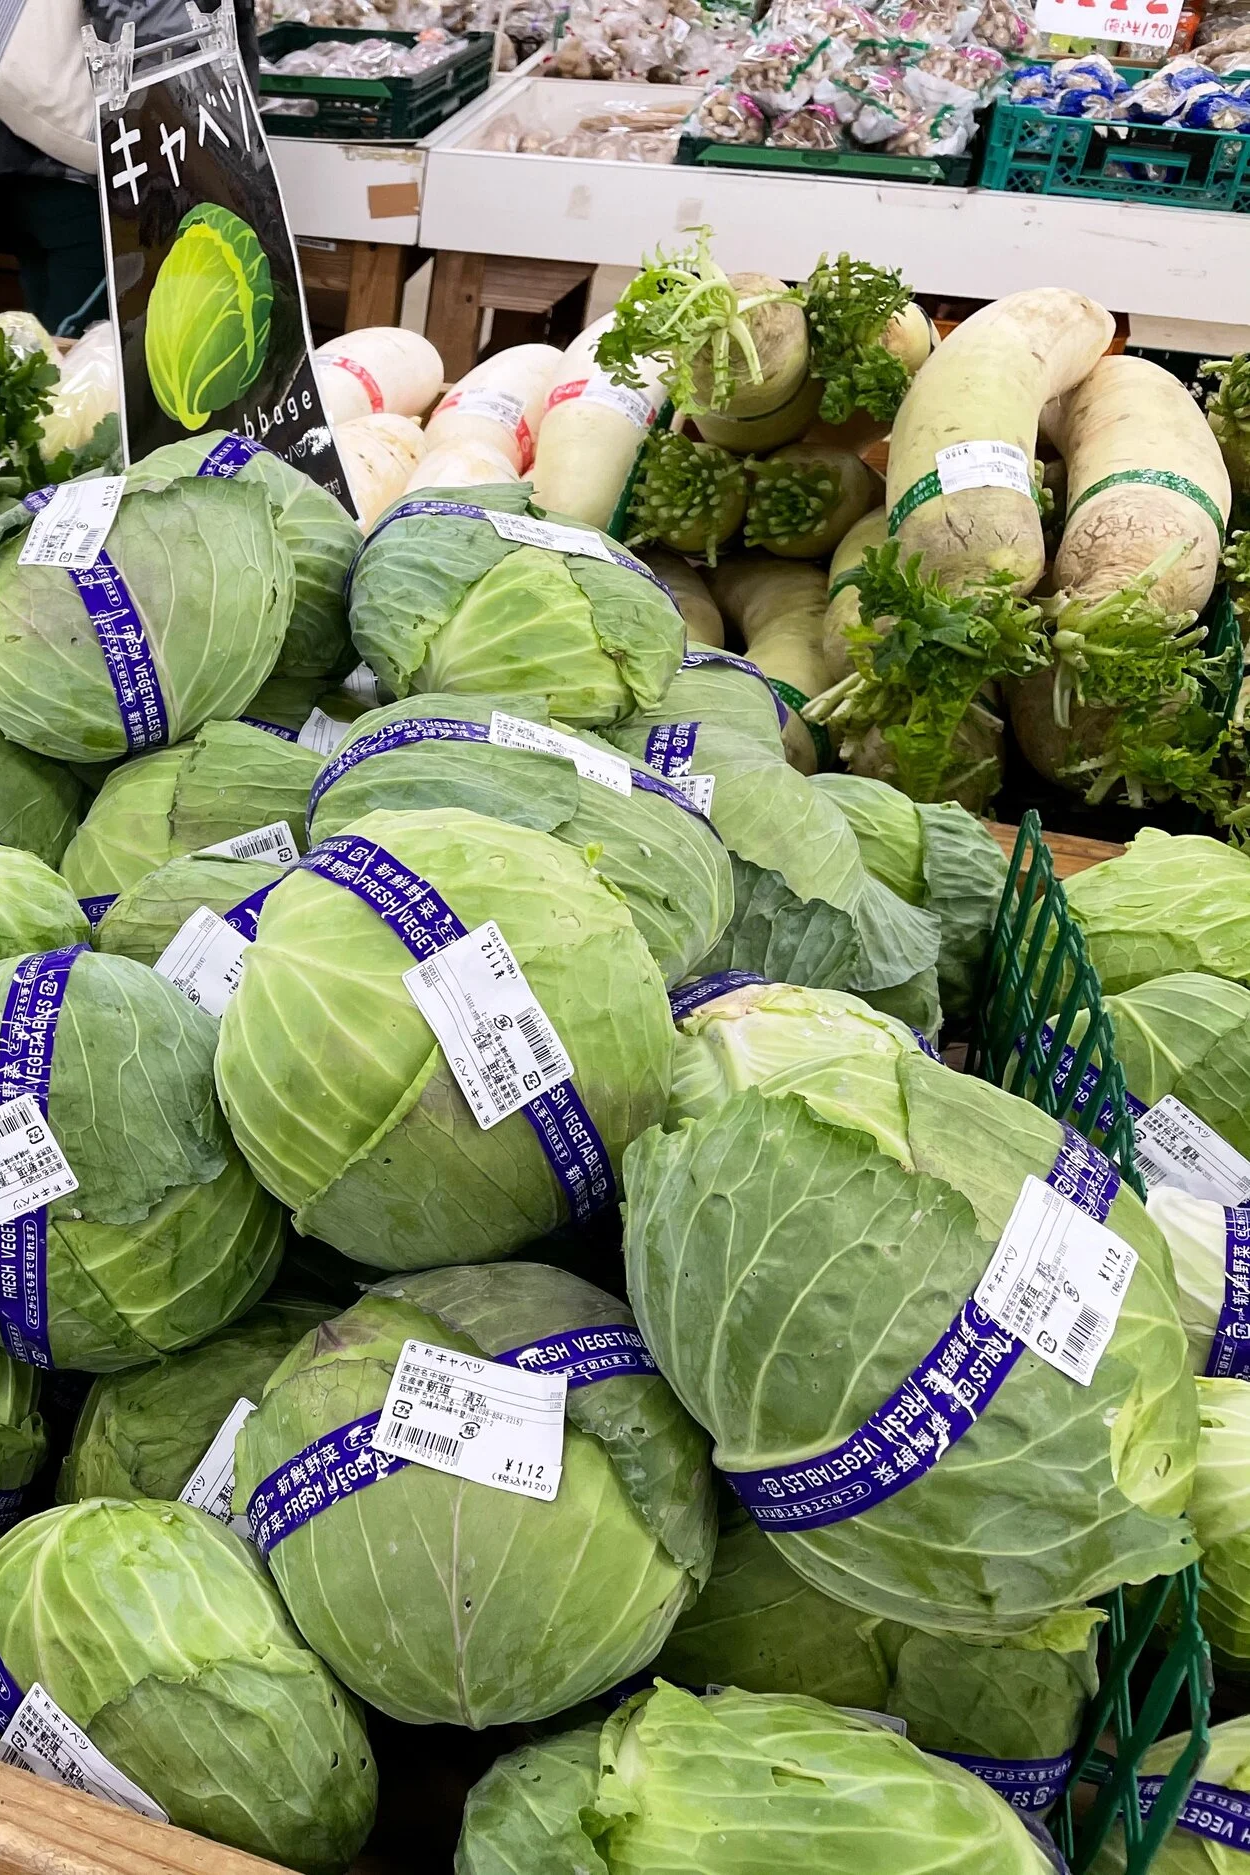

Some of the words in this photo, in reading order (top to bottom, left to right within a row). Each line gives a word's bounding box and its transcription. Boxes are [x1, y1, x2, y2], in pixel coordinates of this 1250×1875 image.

[111, 77, 251, 204] キャベツ
[121, 623, 144, 661] FRESH
[132, 662, 162, 732] VEGETABLES
[359, 874, 401, 914] FRESH
[398, 909, 442, 955] VEGET
[479, 940, 506, 979] ¥112
[453, 1054, 482, 1099] キャベツ
[562, 1106, 604, 1181] VEGETABLES
[10, 1185, 51, 1210] キャベツ
[2, 1262, 18, 1300] FRESH
[25, 1224, 38, 1325] どこからでも手で切れます
[434, 1352, 485, 1374] キャベツ
[276, 1442, 340, 1497] 新鮮野菜
[504, 1455, 544, 1481] ¥112
[781, 1439, 882, 1495] VEGETABLES
[183, 1474, 208, 1506] ャベツ
[285, 1481, 326, 1521] FRESH
[50, 1709, 89, 1754] キャベツ
